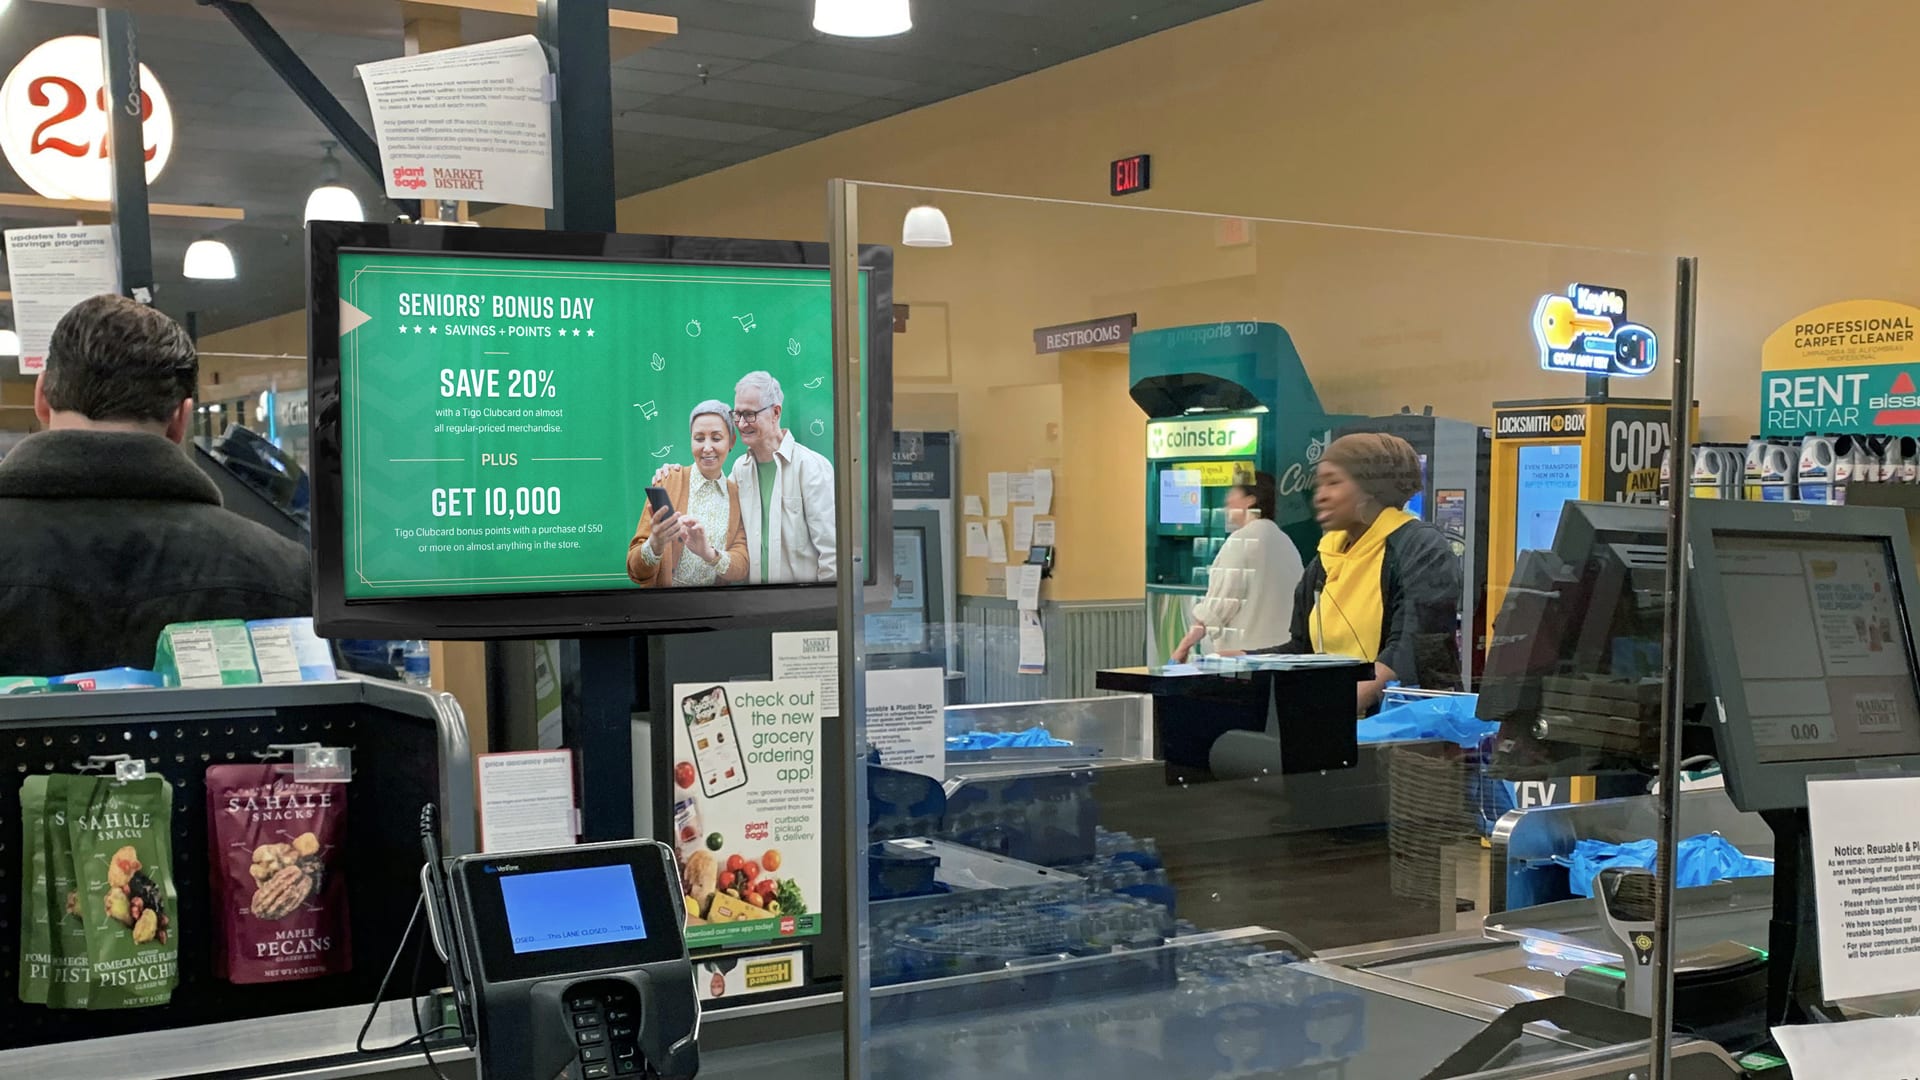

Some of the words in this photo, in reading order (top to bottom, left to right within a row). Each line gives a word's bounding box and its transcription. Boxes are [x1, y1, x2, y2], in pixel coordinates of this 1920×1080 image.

[393, 167, 424, 179] giant
[433, 167, 484, 180] MARKET
[1116, 158, 1140, 191] EXIT
[435, 179, 484, 190] DISTRICT
[10, 233, 54, 242] updates
[11, 241, 51, 249] savings
[54, 239, 105, 248] programs
[492, 294, 554, 319] BONUS
[560, 297, 594, 320] DAY
[1577, 287, 1624, 316] KeyMe
[444, 324, 496, 337] SAVINGS
[508, 325, 552, 338] POINTS
[1795, 316, 1914, 336] PROFESSIONAL
[1046, 324, 1121, 350] RESTROOMS
[1794, 335, 1846, 349] CARPET
[1849, 331, 1914, 345] CLEANER
[440, 367, 500, 398] SAVE
[508, 369, 556, 398] 20%
[1769, 373, 1870, 409] RENT
[435, 408, 453, 417] with
[463, 408, 481, 419] Tigo
[483, 408, 521, 417] Clubcard
[535, 408, 563, 417] almost
[1768, 407, 1860, 429] RENTAR
[434, 424, 444, 433] all
[446, 424, 505, 435] regular-priced
[507, 424, 563, 433] merchandise.
[1497, 415, 1550, 433] LOCKSMITH
[1564, 414, 1586, 431] BOX
[1166, 426, 1236, 448] coinstar
[481, 453, 518, 466] PLUS
[1280, 462, 1317, 496] Coi
[1631, 471, 1655, 490] ANY
[431, 487, 477, 517] GET
[485, 486, 561, 520] 10,000
[394, 528, 414, 539] Tigo
[415, 527, 455, 537] Clubcard
[456, 526, 483, 536] bonus
[484, 525, 511, 536] points
[512, 525, 531, 535] with
[532, 527, 537, 535] a
[538, 524, 576, 536] purchase
[578, 524, 587, 534] of
[587, 524, 603, 534] $50
[429, 544, 451, 552] more
[466, 542, 495, 550] almost
[496, 541, 532, 552] anything
[534, 541, 541, 549] in
[543, 541, 556, 549] the
[558, 540, 581, 549] store.
[735, 692, 784, 708] check
[789, 691, 815, 706] out
[751, 711, 776, 726] the
[782, 711, 815, 725] new
[1790, 723, 1820, 740] 0.00
[752, 730, 814, 749] grocery
[747, 747, 814, 765] ordering
[777, 764, 814, 784] app!
[228, 793, 332, 813] SAHALE
[78, 812, 151, 831] SAHALE
[252, 810, 315, 822] SNACKS
[774, 815, 810, 824] curbside
[745, 821, 769, 832] giant
[774, 825, 803, 834] pickup
[744, 831, 769, 840] eagle
[782, 832, 815, 841] delivery
[1834, 845, 1865, 857] Notice:
[1866, 842, 1904, 855] Reusable
[1905, 841, 1911, 852] &
[1847, 877, 1861, 885] have
[1851, 886, 1881, 896] regarding
[1844, 900, 1863, 908] Please
[1845, 908, 1870, 917] reusable
[1845, 921, 1856, 929] We
[1856, 920, 1871, 928] have
[275, 928, 315, 940] MAPLE
[562, 930, 581, 938] LANE
[255, 936, 331, 957] PECANS
[1847, 942, 1858, 950] For
[93, 955, 158, 973] POMEGRANATE
